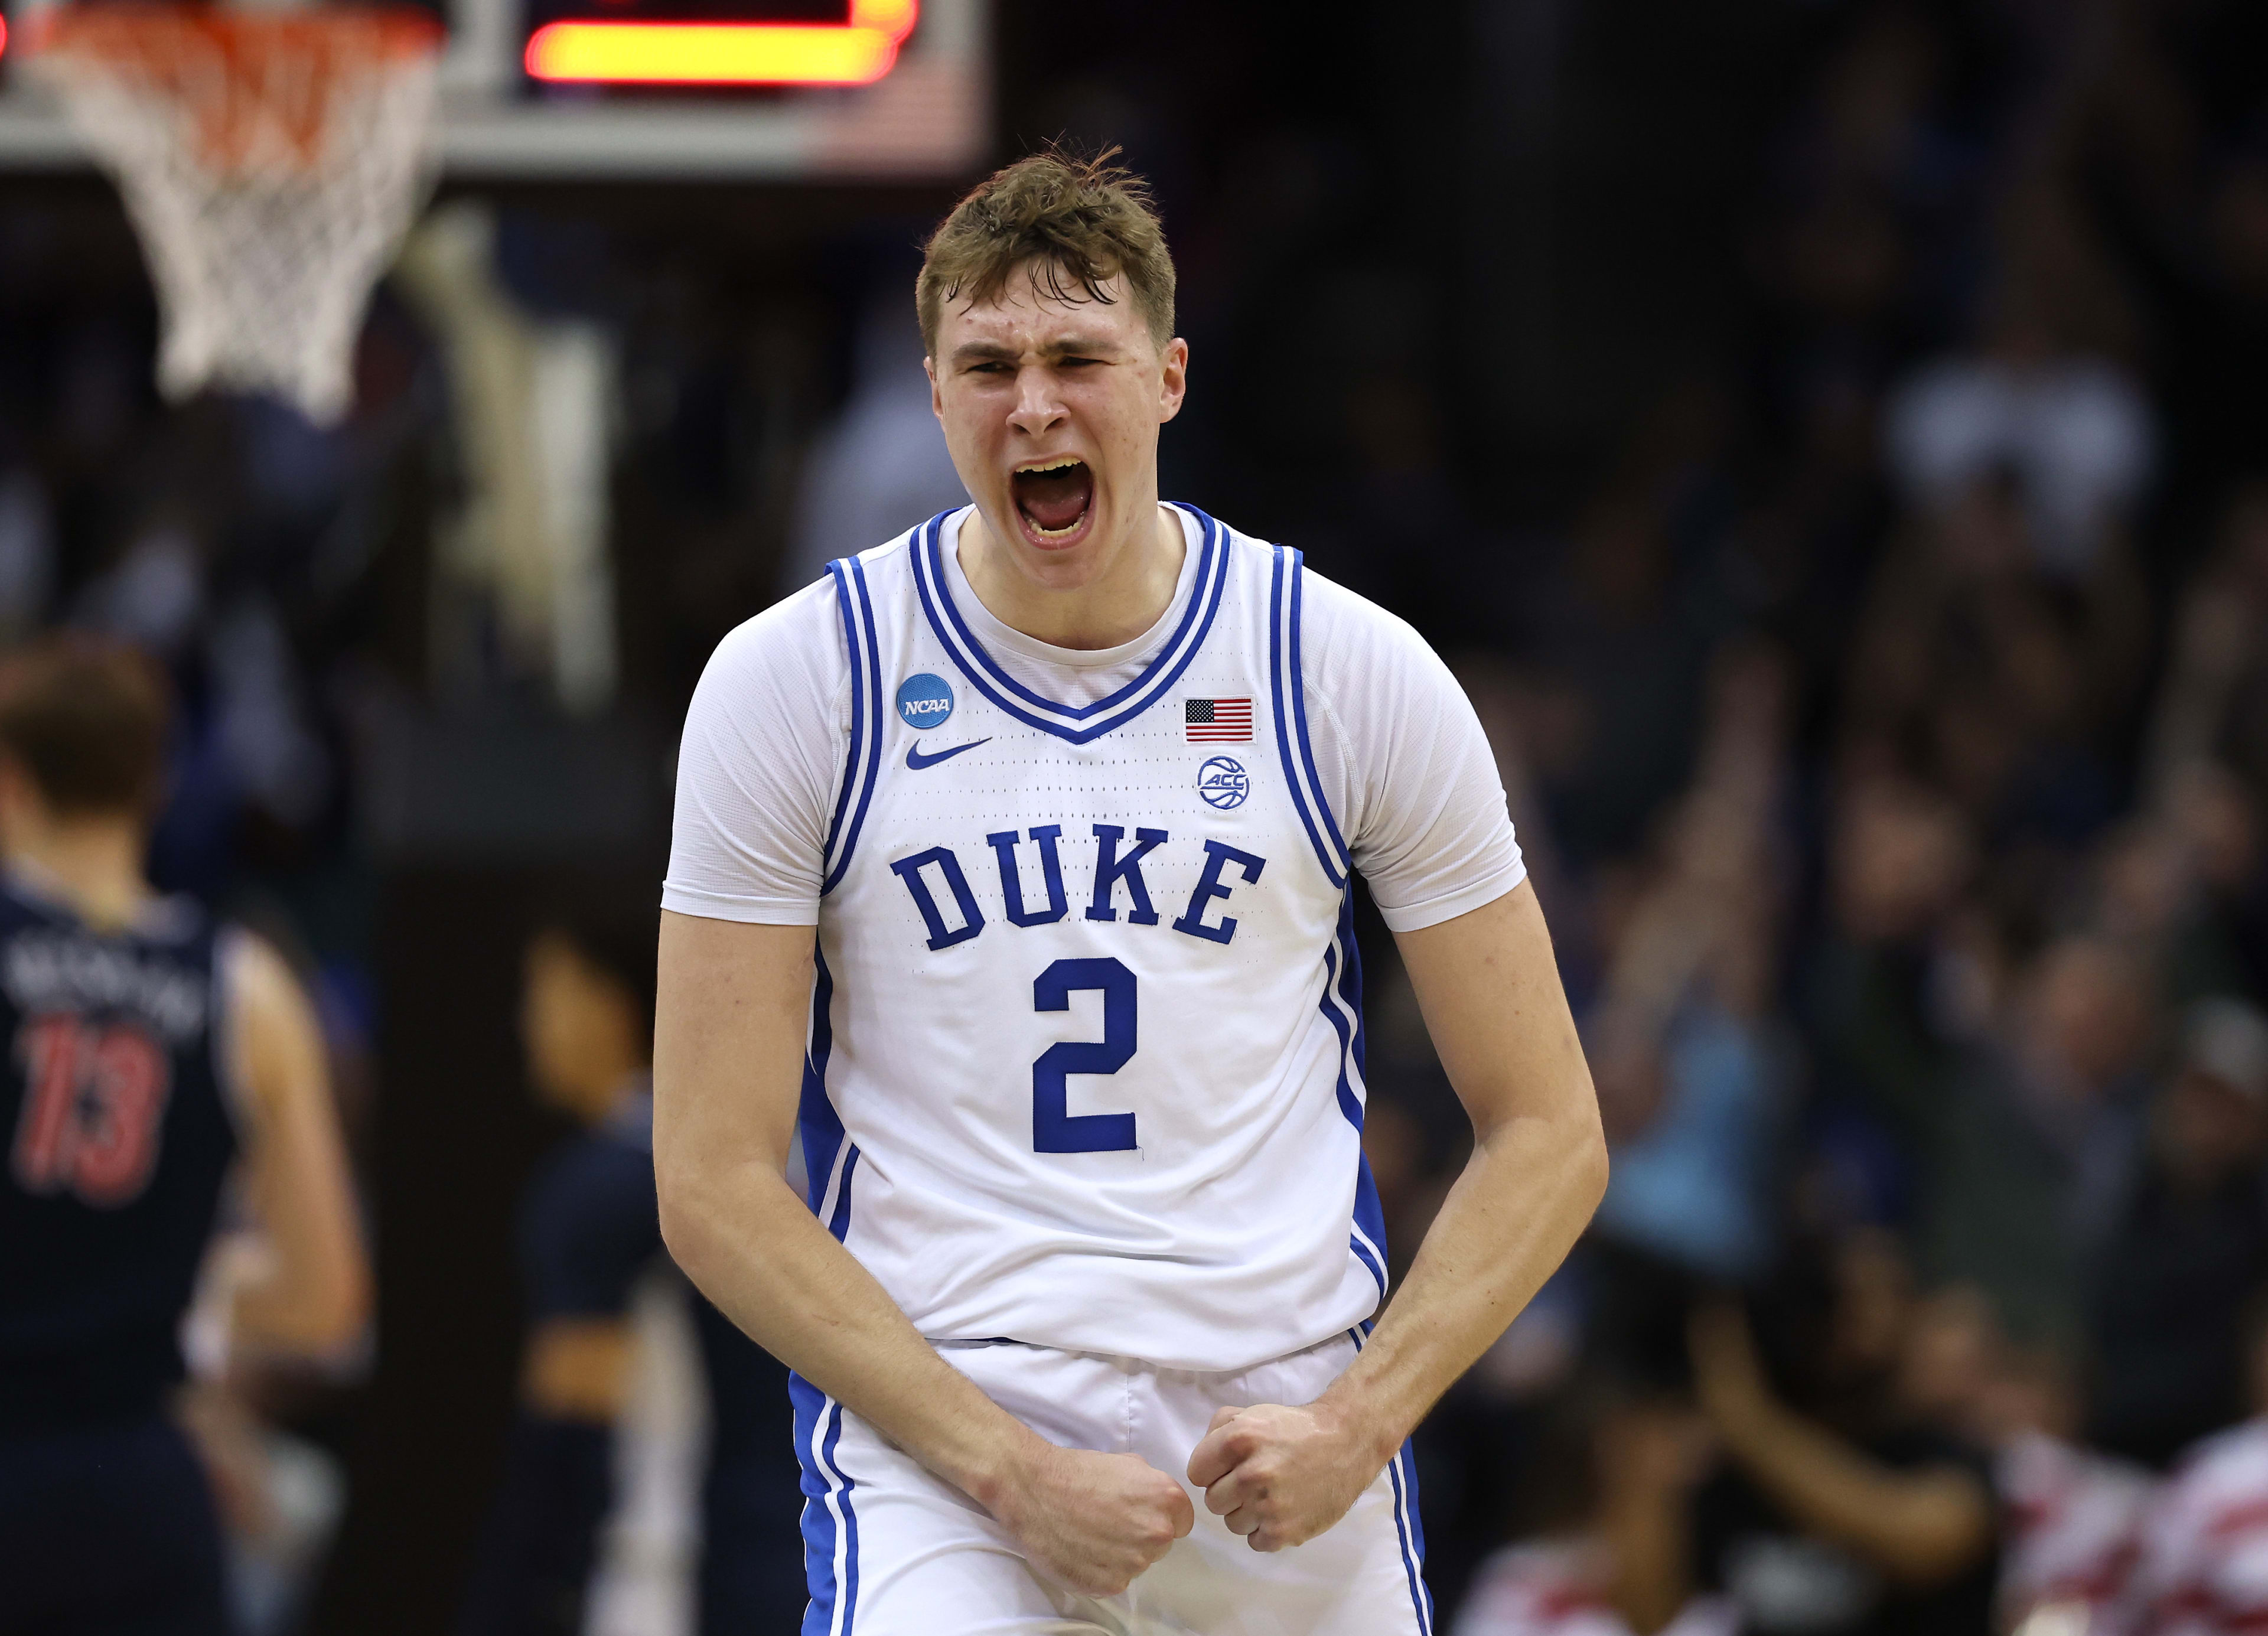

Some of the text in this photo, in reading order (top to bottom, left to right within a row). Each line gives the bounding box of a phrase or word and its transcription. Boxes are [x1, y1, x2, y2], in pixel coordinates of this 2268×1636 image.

[905, 699, 950, 715] NCAA
[1205, 774, 1247, 786] ACC
[889, 824, 1266, 951] DUKE
[1032, 957, 1138, 1153] 2
